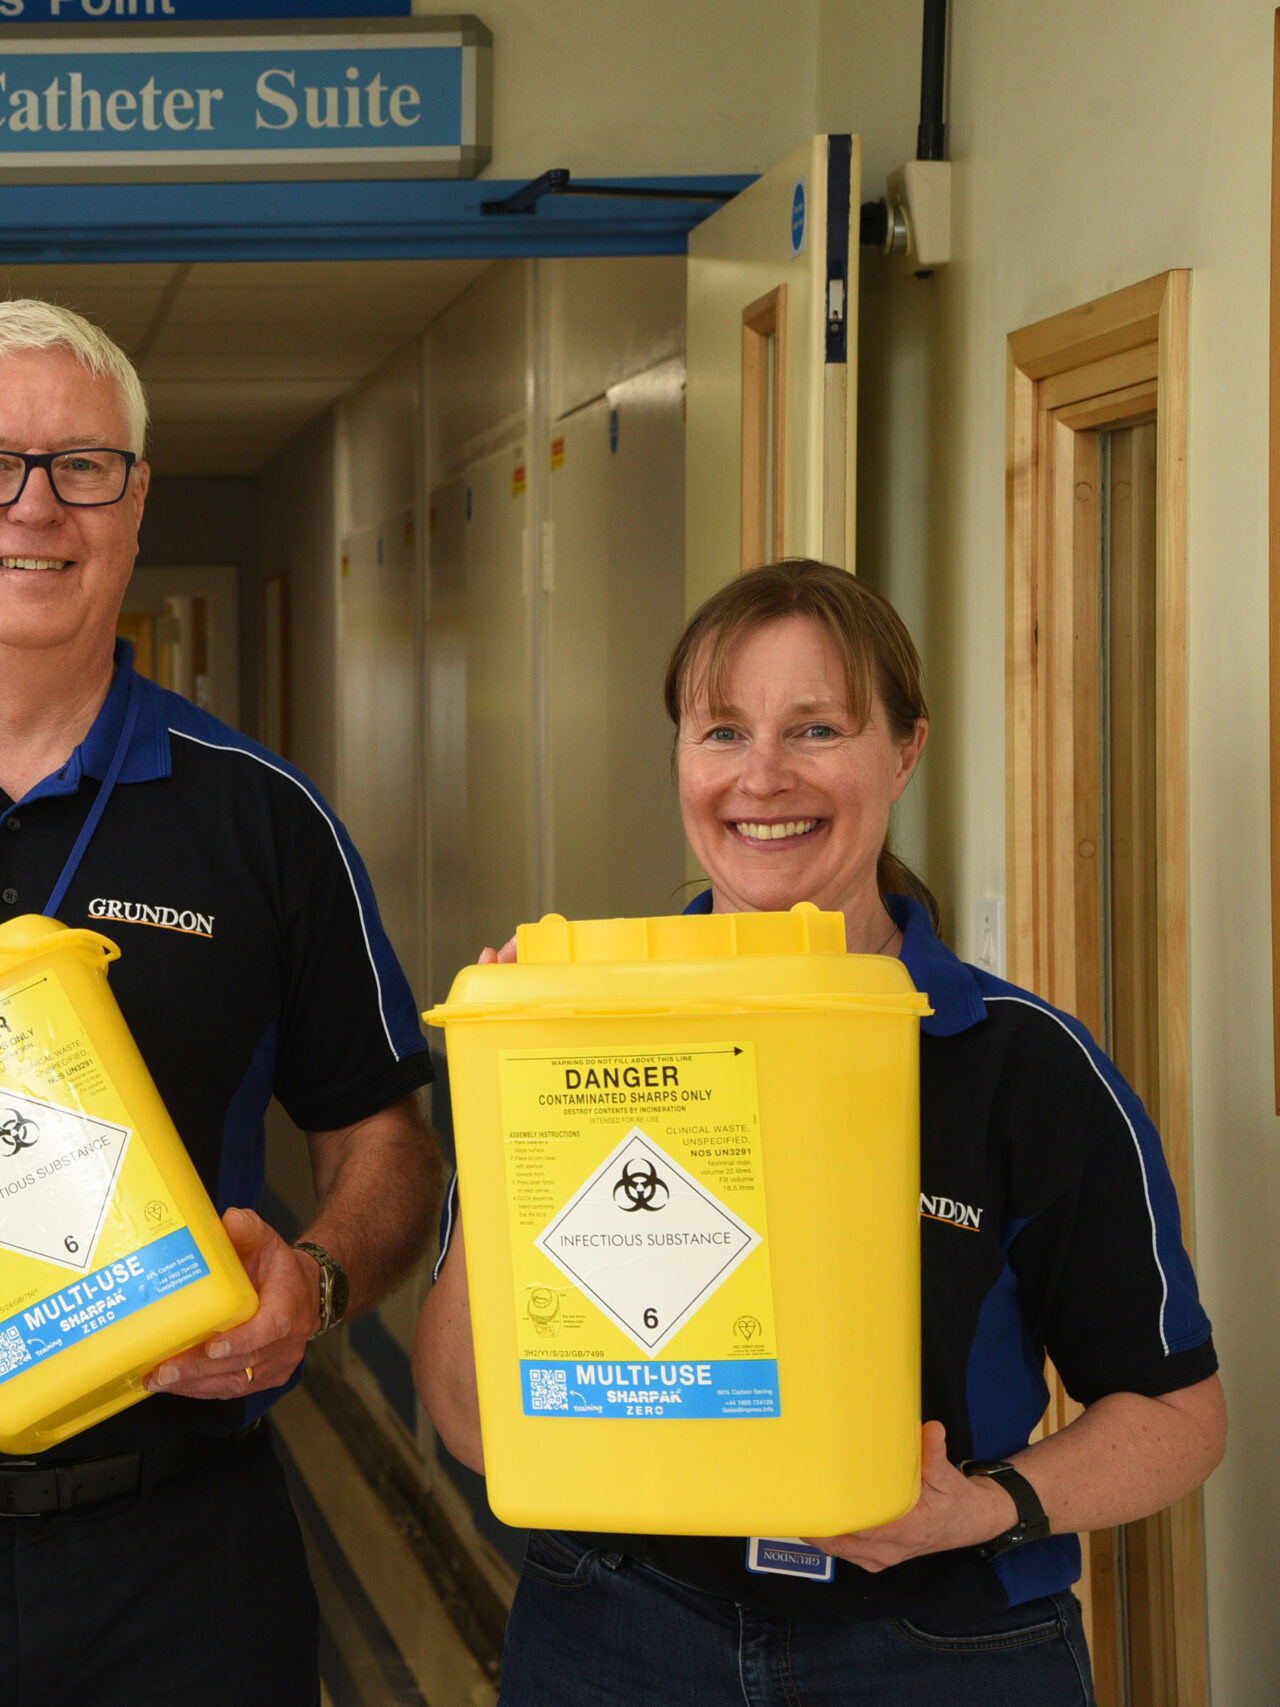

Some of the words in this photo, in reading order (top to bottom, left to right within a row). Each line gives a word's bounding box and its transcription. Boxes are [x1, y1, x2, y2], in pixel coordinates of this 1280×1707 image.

[256, 66, 421, 130] Suite
[88, 898, 215, 935] GRUNDON
[8, 1027, 35, 1046] ONLY
[47, 1071, 65, 1085] NOS
[65, 1057, 93, 1076] UN3291
[565, 1065, 679, 1090] DANGER
[538, 1092, 627, 1106] CONTAMINATED
[630, 1091, 677, 1103] SHARPS
[681, 1090, 712, 1101] ONLY
[594, 1107, 628, 1115] CONTENTS
[666, 1126, 711, 1135] CLINICAL
[34, 1134, 112, 1180] SUBSTANCE
[715, 1148, 751, 1157] UN3291
[920, 1192, 983, 1228] NDON
[62, 1233, 80, 1255] 6
[560, 1234, 643, 1247] INFECTIOUS
[647, 1232, 731, 1246] SUBSTANCE
[20, 1254, 147, 1331] MULTI-USE
[56, 1287, 128, 1333] SHARPAK
[643, 1307, 658, 1329] 6
[80, 1309, 117, 1334] ZERO
[33, 1336, 64, 1358] Training
[576, 1364, 712, 1386] MULTI-USE
[607, 1389, 682, 1404] SHARPAK
[626, 1405, 664, 1415] ZERO
[763, 1551, 821, 1567] GRUNDON
